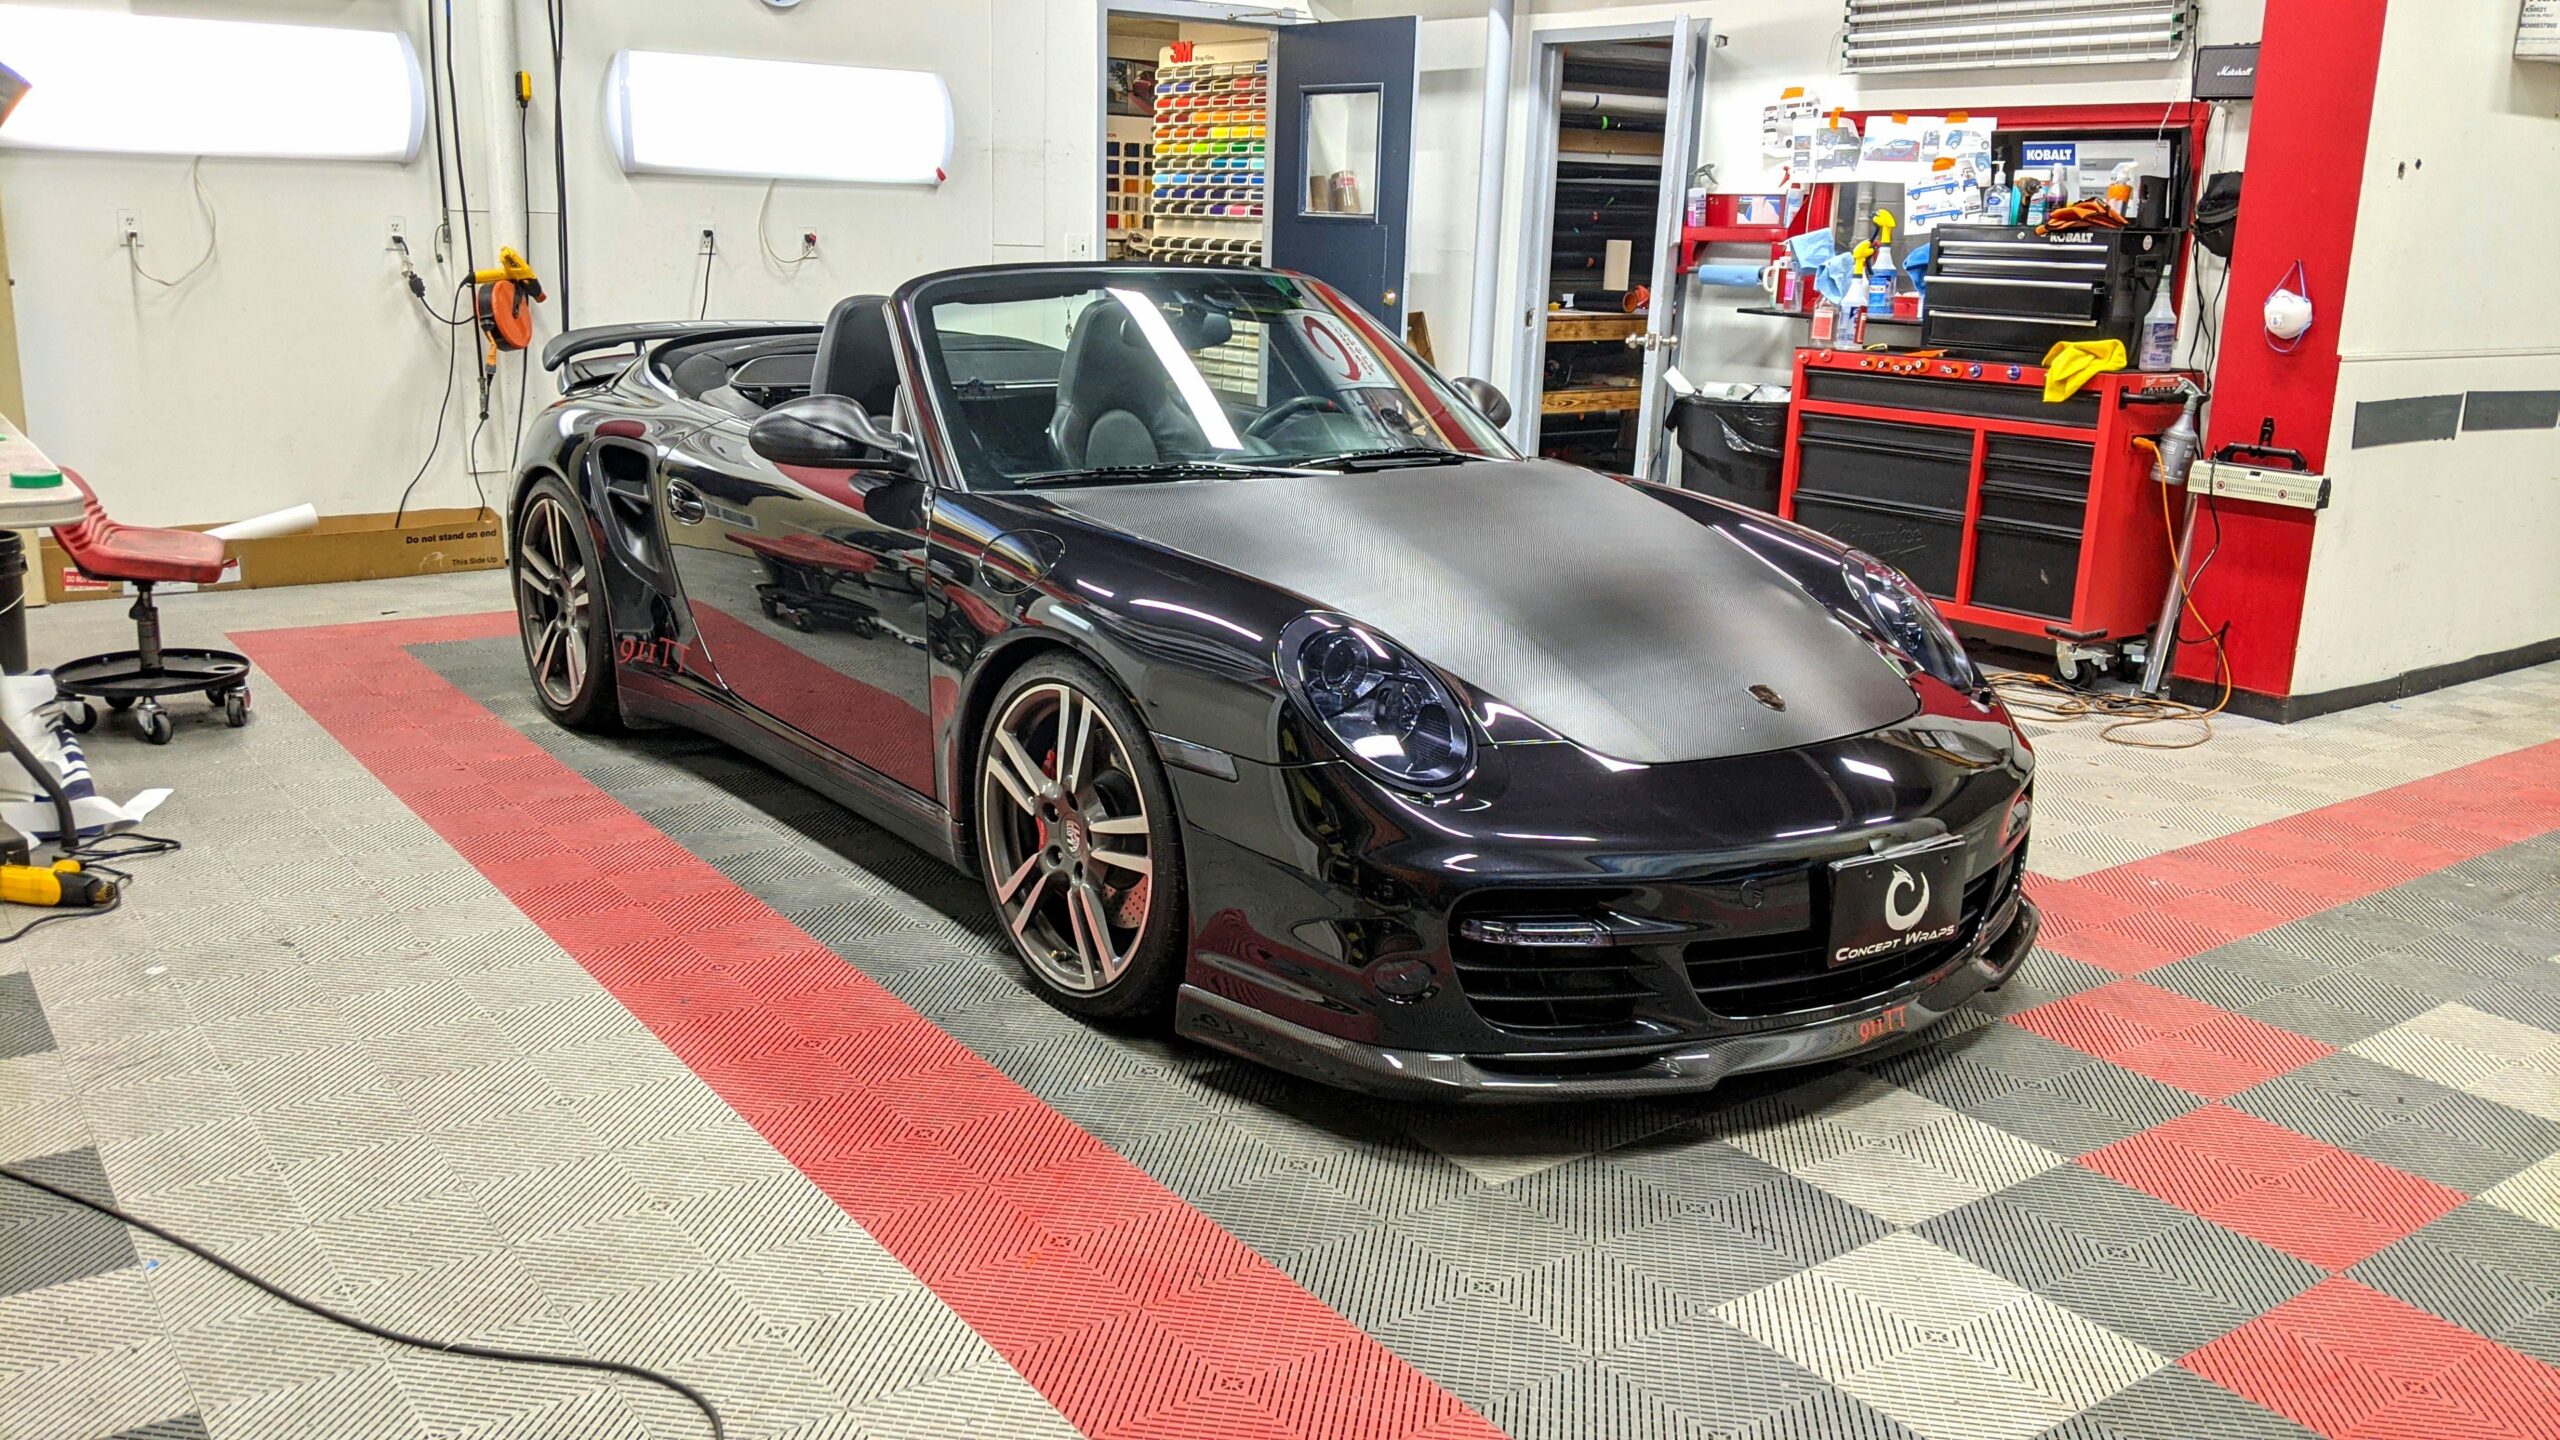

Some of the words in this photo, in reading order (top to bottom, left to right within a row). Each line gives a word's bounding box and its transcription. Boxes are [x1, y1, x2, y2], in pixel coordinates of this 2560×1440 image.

[1170, 41, 1193, 63] 3M
[2217, 65, 2253, 76] Marshall
[2026, 149, 2072, 161] KOBALT
[2050, 232, 2094, 243] KOBALT
[406, 536, 419, 545] Do
[421, 534, 436, 543] not
[439, 532, 464, 541] stand
[466, 531, 478, 539] on
[480, 529, 497, 537] end
[487, 556, 498, 564] Up
